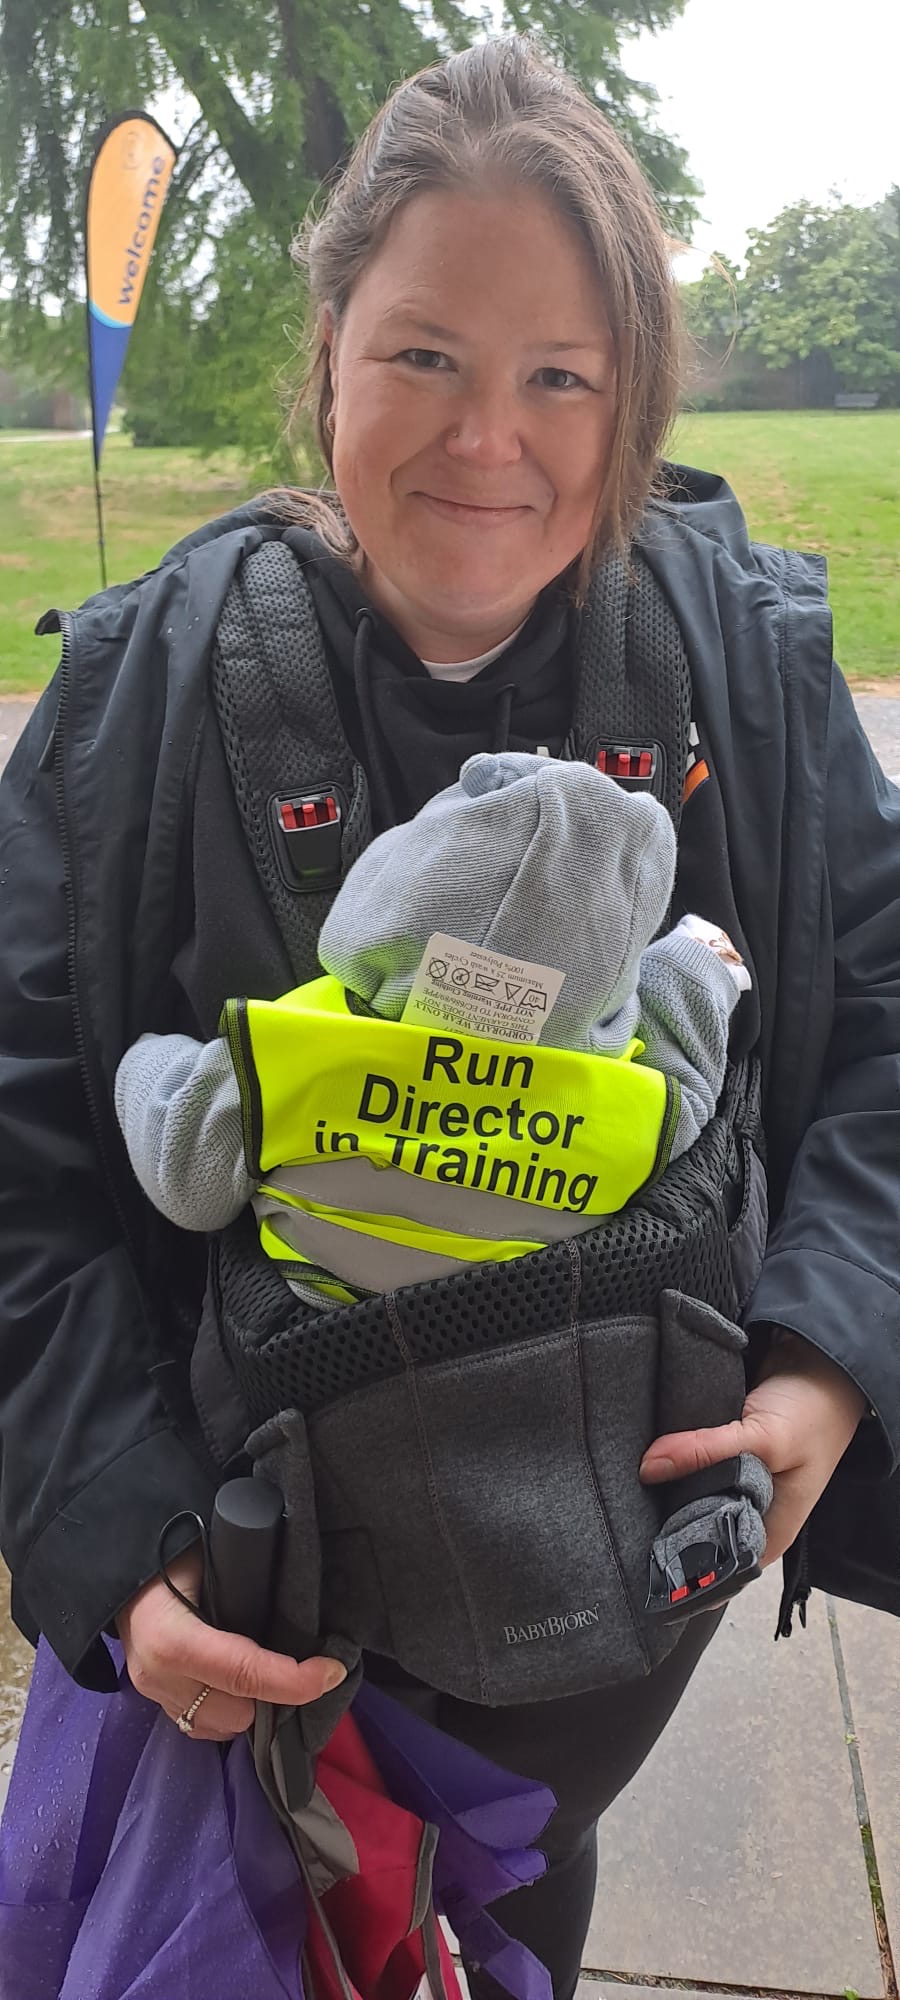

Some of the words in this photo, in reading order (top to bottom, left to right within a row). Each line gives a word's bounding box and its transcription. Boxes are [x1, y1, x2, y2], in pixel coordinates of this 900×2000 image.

[118, 155, 166, 305] welcome
[443, 951, 469, 966] Cycles
[469, 951, 503, 968] Polyester
[430, 978, 460, 995] Clothing
[506, 973, 543, 989] Maximum
[422, 995, 440, 1007] NOT
[462, 990, 492, 1006] Warning
[413, 1001, 440, 1017] ONLY
[442, 1003, 465, 1016] DOES
[479, 1006, 491, 1016] TO
[493, 1001, 512, 1012] PPE
[515, 1007, 534, 1017] NOT
[442, 1012, 471, 1028] WEAR
[467, 1013, 509, 1026] GARMENT
[493, 1012, 535, 1024] CONFORM
[473, 1023, 533, 1041] CORPORATE
[510, 1022, 528, 1031] THIS
[422, 1036, 534, 1089] Run
[357, 1073, 585, 1149] Director
[315, 1120, 359, 1153] in
[384, 1133, 598, 1213] Training
